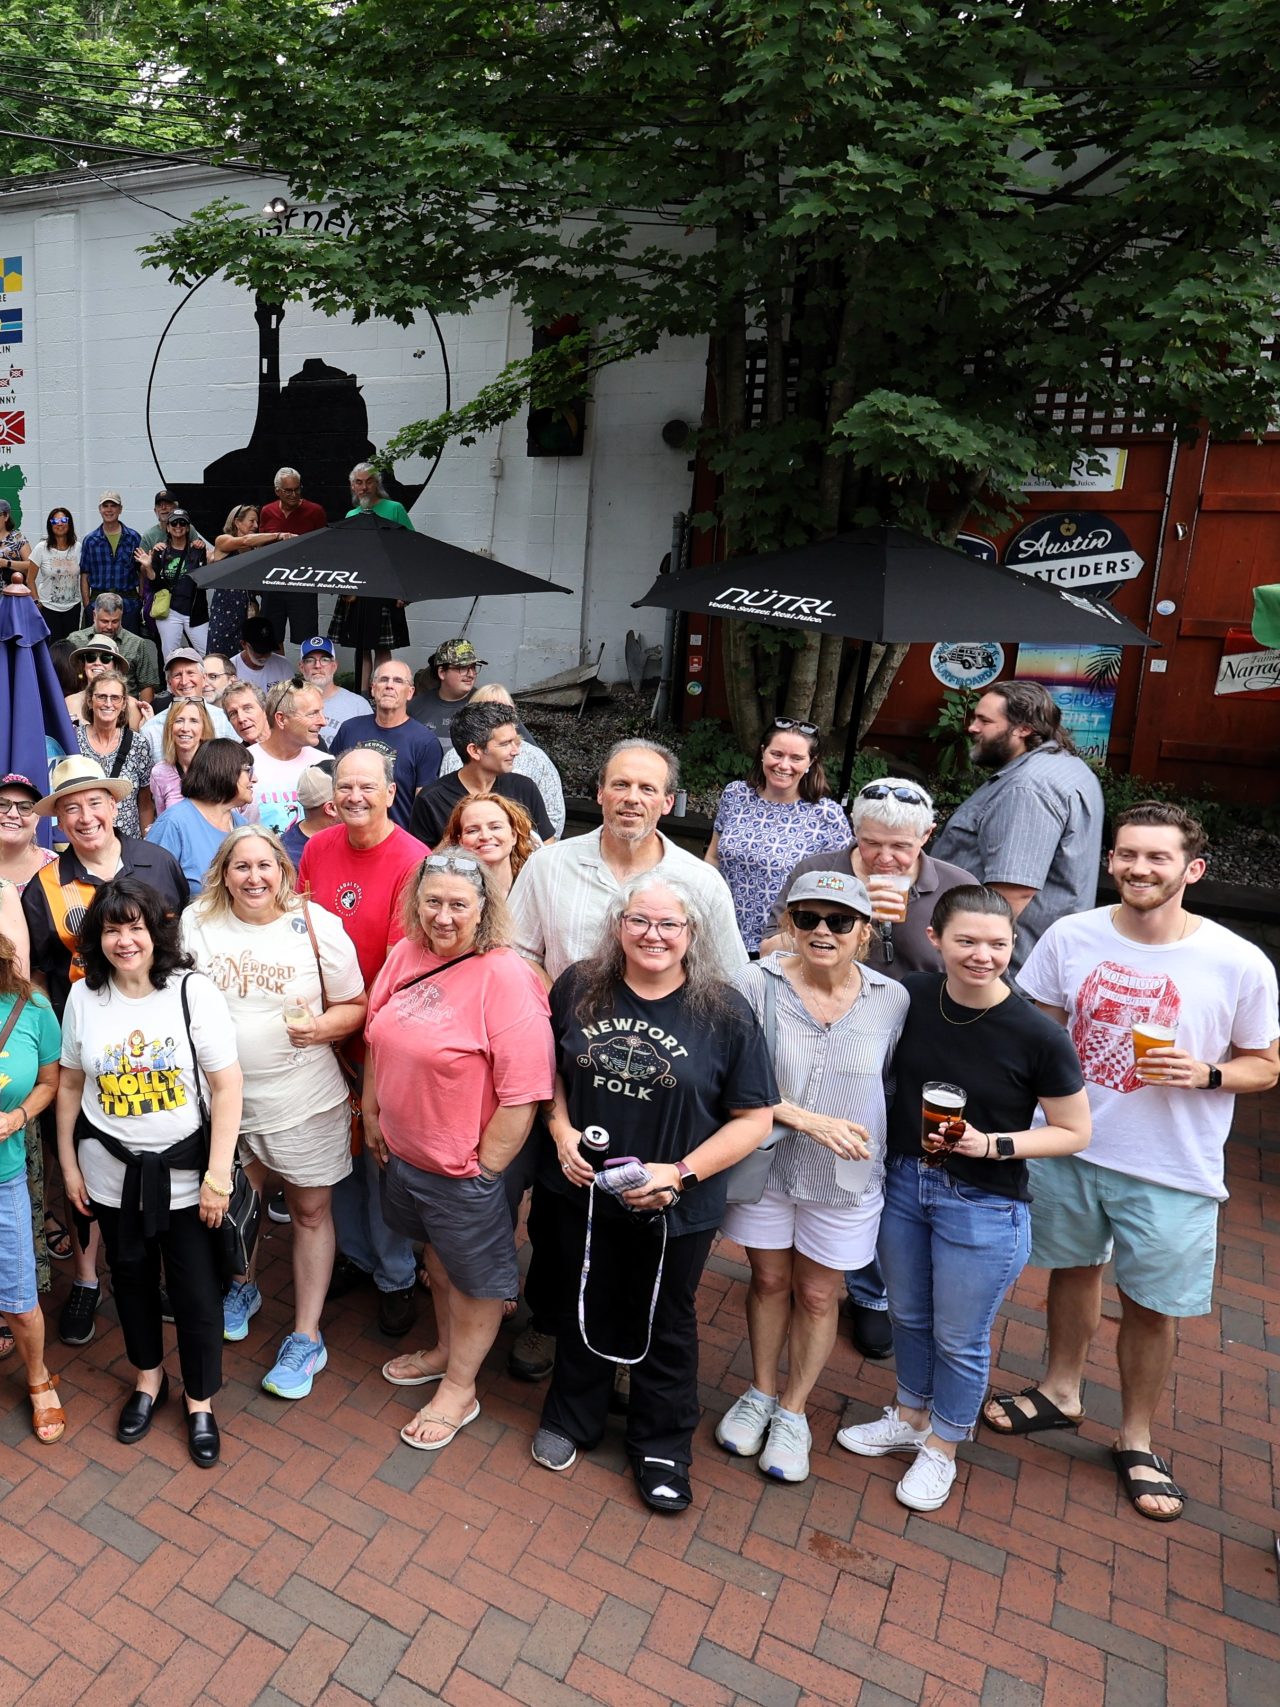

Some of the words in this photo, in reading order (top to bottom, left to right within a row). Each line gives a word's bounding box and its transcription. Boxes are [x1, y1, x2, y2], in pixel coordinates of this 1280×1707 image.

[1018, 529, 1112, 558] Austin
[1032, 558, 1130, 583] STCIDERS
[708, 601, 737, 611] Vodka.
[737, 605, 770, 616] Seltzer.
[772, 610, 794, 620] Real
[794, 613, 822, 624] Juice.
[364, 742, 389, 752] NEWPORT
[581, 1018, 689, 1058] NEWPORT
[98, 1067, 183, 1096] MOLLY
[593, 1075, 654, 1101] FOLK
[99, 1084, 188, 1117] TUTTLE
